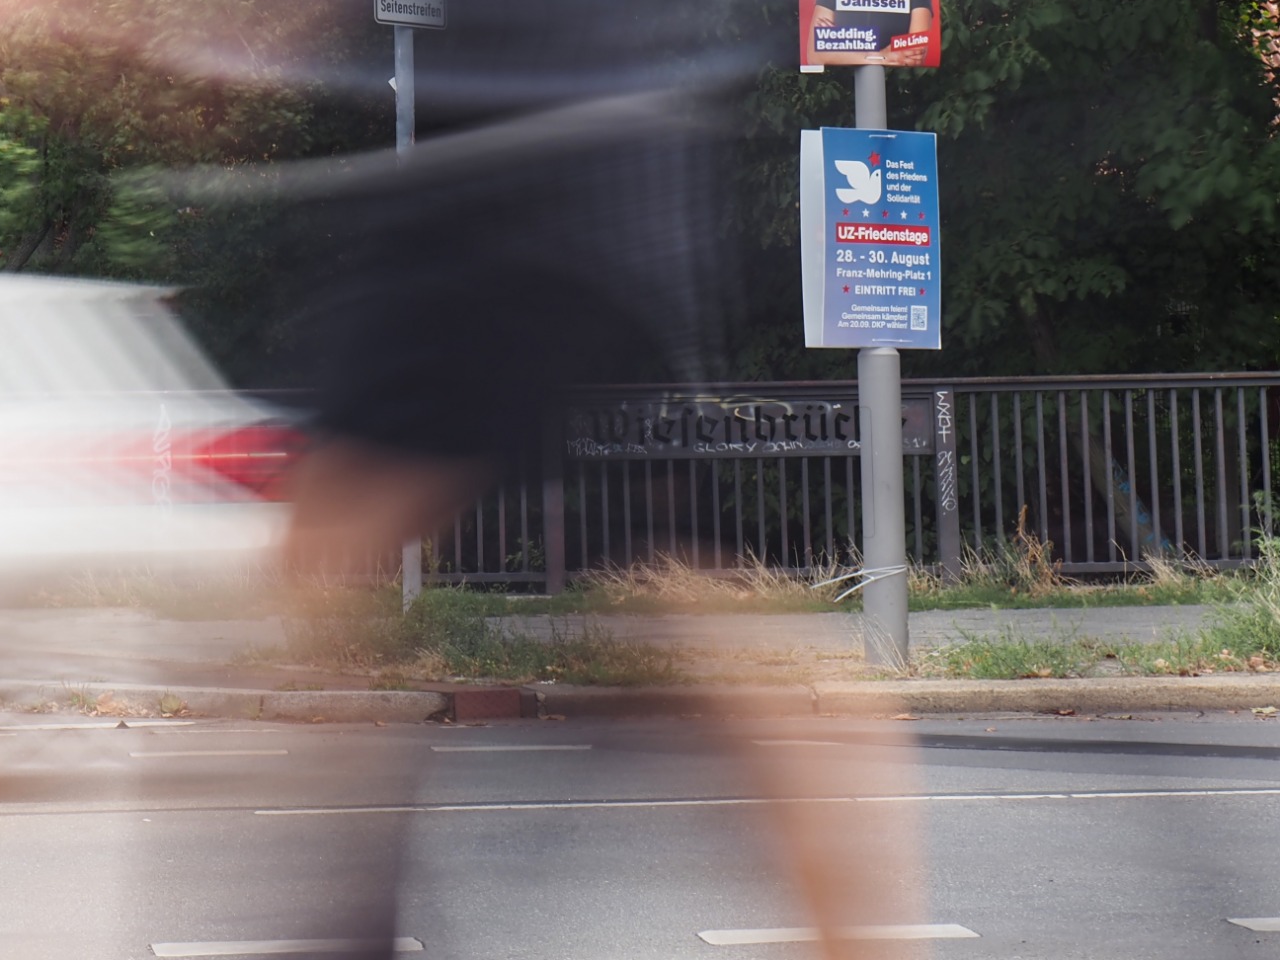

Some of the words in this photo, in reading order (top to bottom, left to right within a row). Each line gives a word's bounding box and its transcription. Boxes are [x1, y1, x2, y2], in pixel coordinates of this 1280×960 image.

[816, 28, 877, 42] Wedding.
[816, 40, 877, 50] Bezahlbar
[894, 39, 907, 48] Die
[908, 35, 929, 45] Linke
[886, 160, 899, 169] Das
[900, 161, 914, 169] Fest
[886, 172, 899, 180] des
[900, 172, 927, 182] Friedens
[886, 183, 899, 191] und
[900, 184, 912, 192] der
[886, 194, 921, 204] Solidarität
[838, 226, 928, 245] UZ-Friedenstage
[836, 249, 857, 262] 28.
[869, 250, 888, 263] 30.
[891, 252, 930, 267] August
[836, 268, 925, 281] Franz-Mehring-Platz
[926, 271, 931, 280] 1
[855, 285, 896, 296] EINTRITT
[898, 286, 916, 296] FREI
[851, 304, 889, 312] Gemeinsam
[841, 312, 881, 320] Gemeinsam
[838, 320, 849, 328] Am
[872, 321, 886, 329] DKP
